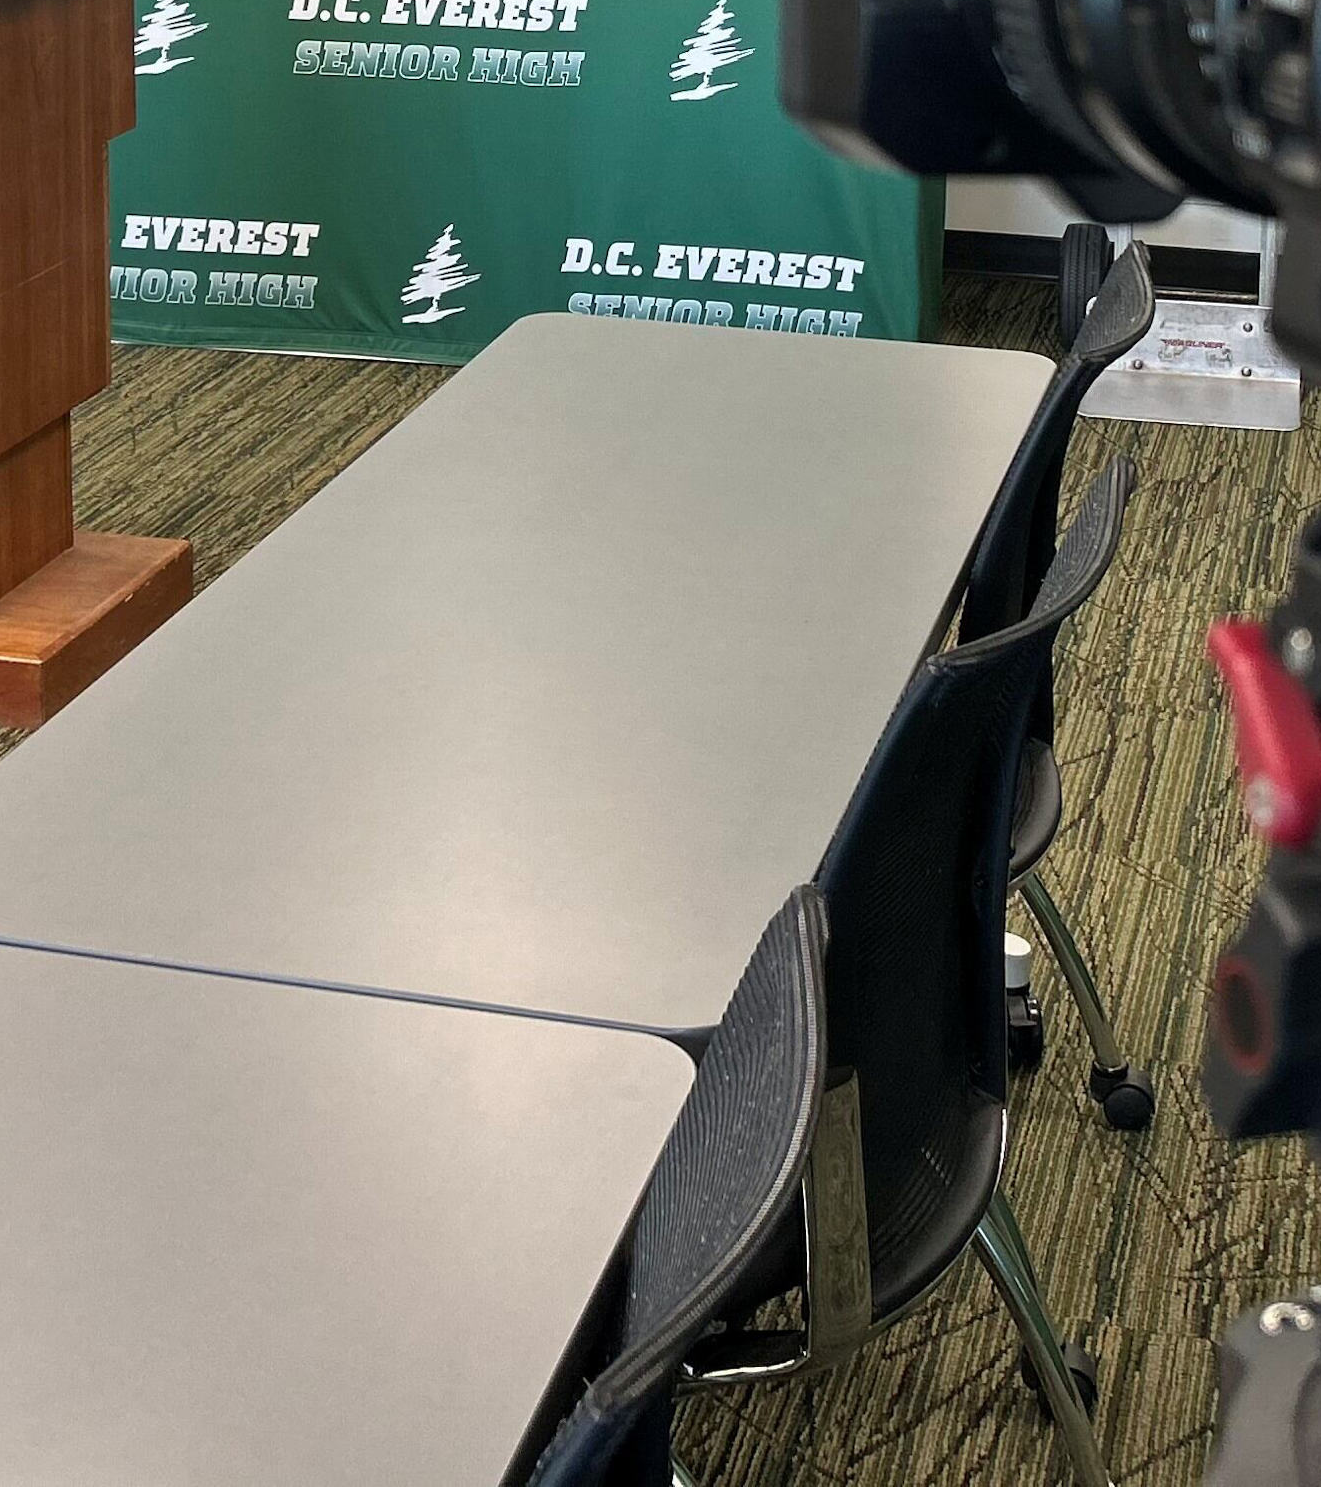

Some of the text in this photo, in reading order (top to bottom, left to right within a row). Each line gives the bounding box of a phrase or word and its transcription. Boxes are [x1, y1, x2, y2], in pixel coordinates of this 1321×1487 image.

[293, 40, 585, 86] SENIOR HIGH
[121, 215, 320, 256] EVEREST
[561, 239, 864, 291] D.C. EVEREST
[110, 266, 318, 308] IOR HIGH
[744, 303, 863, 338] HIGH
